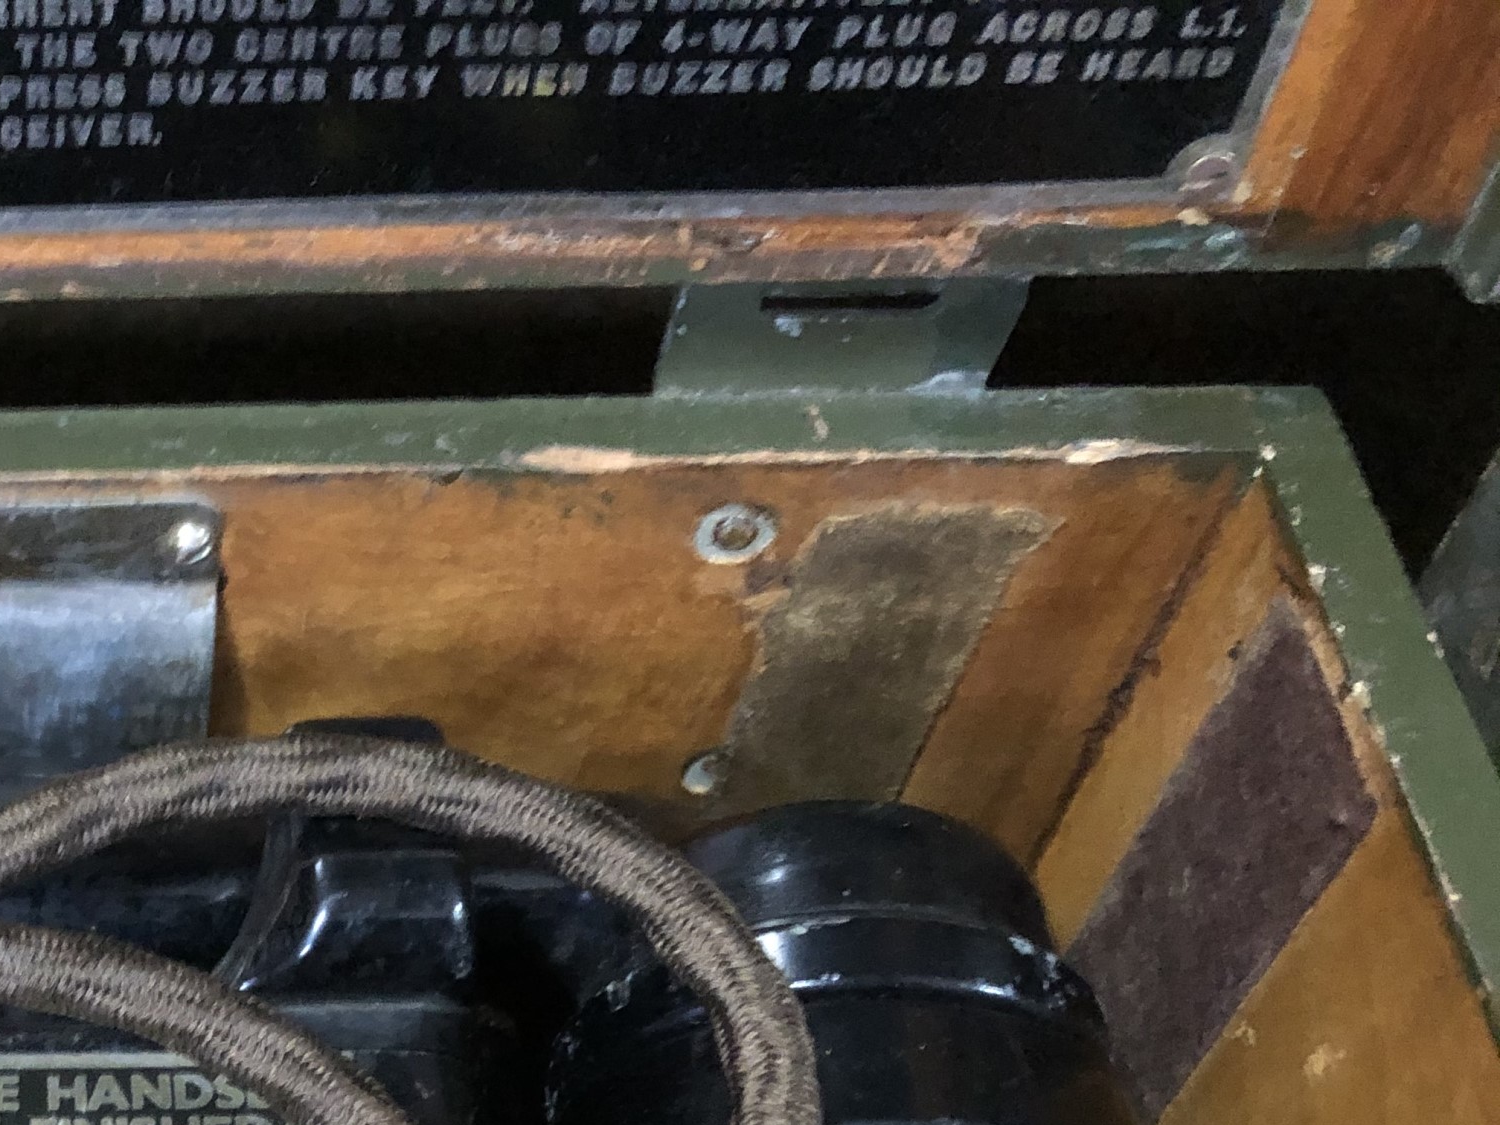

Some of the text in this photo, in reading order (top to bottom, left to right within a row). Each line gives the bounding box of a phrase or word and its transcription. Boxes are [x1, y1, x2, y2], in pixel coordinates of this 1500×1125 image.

[14, 32, 96, 70] THE
[118, 29, 213, 67] TWO
[234, 24, 405, 63] CENTRE
[425, 20, 562, 59] PLUGS
[585, 19, 642, 56] OF
[661, 15, 811, 53] 4-WAY
[833, 12, 957, 49] PLUG
[975, 6, 1159, 45] ACROSS
[147, 67, 328, 107] BUZZER
[349, 65, 440, 101] KEY
[461, 62, 589, 98] WHEN
[608, 57, 791, 97] BUZZER
[807, 52, 987, 93] SHOULD
[1003, 49, 1065, 85] BE
[1079, 45, 1236, 83] HEARD
